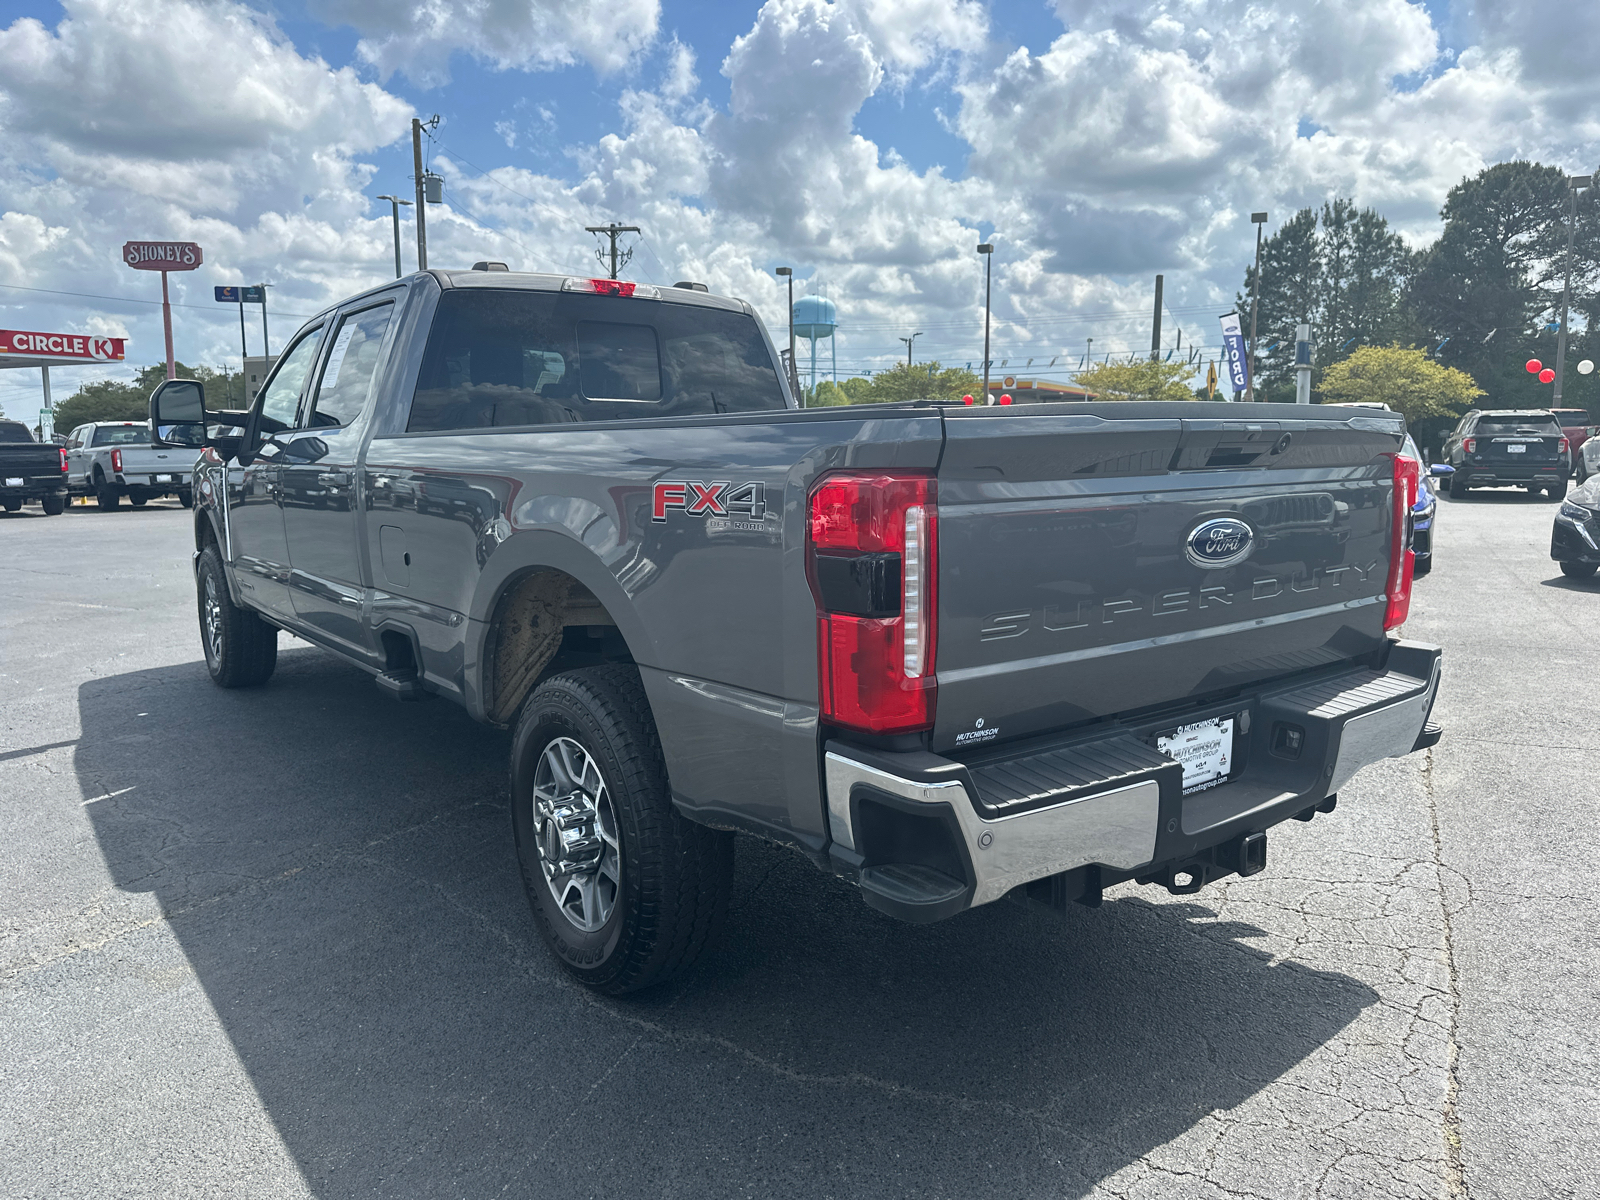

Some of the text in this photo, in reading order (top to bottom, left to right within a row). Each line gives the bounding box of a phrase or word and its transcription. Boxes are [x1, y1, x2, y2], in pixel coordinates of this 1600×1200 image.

[127, 244, 196, 265] SHONEY'S
[12, 333, 112, 359] CIRCLE K
[652, 480, 766, 524] FX4
[734, 521, 765, 532] ROAD
[1206, 528, 1244, 553] Ford
[980, 559, 1378, 642] SUPER DUTY
[955, 727, 1000, 741] HUTCHINSON
[1184, 717, 1220, 732] HUTCHINSON
[1173, 740, 1222, 759] HUTCHINSON
[1179, 749, 1219, 764] TOMOTIVE GROUP
